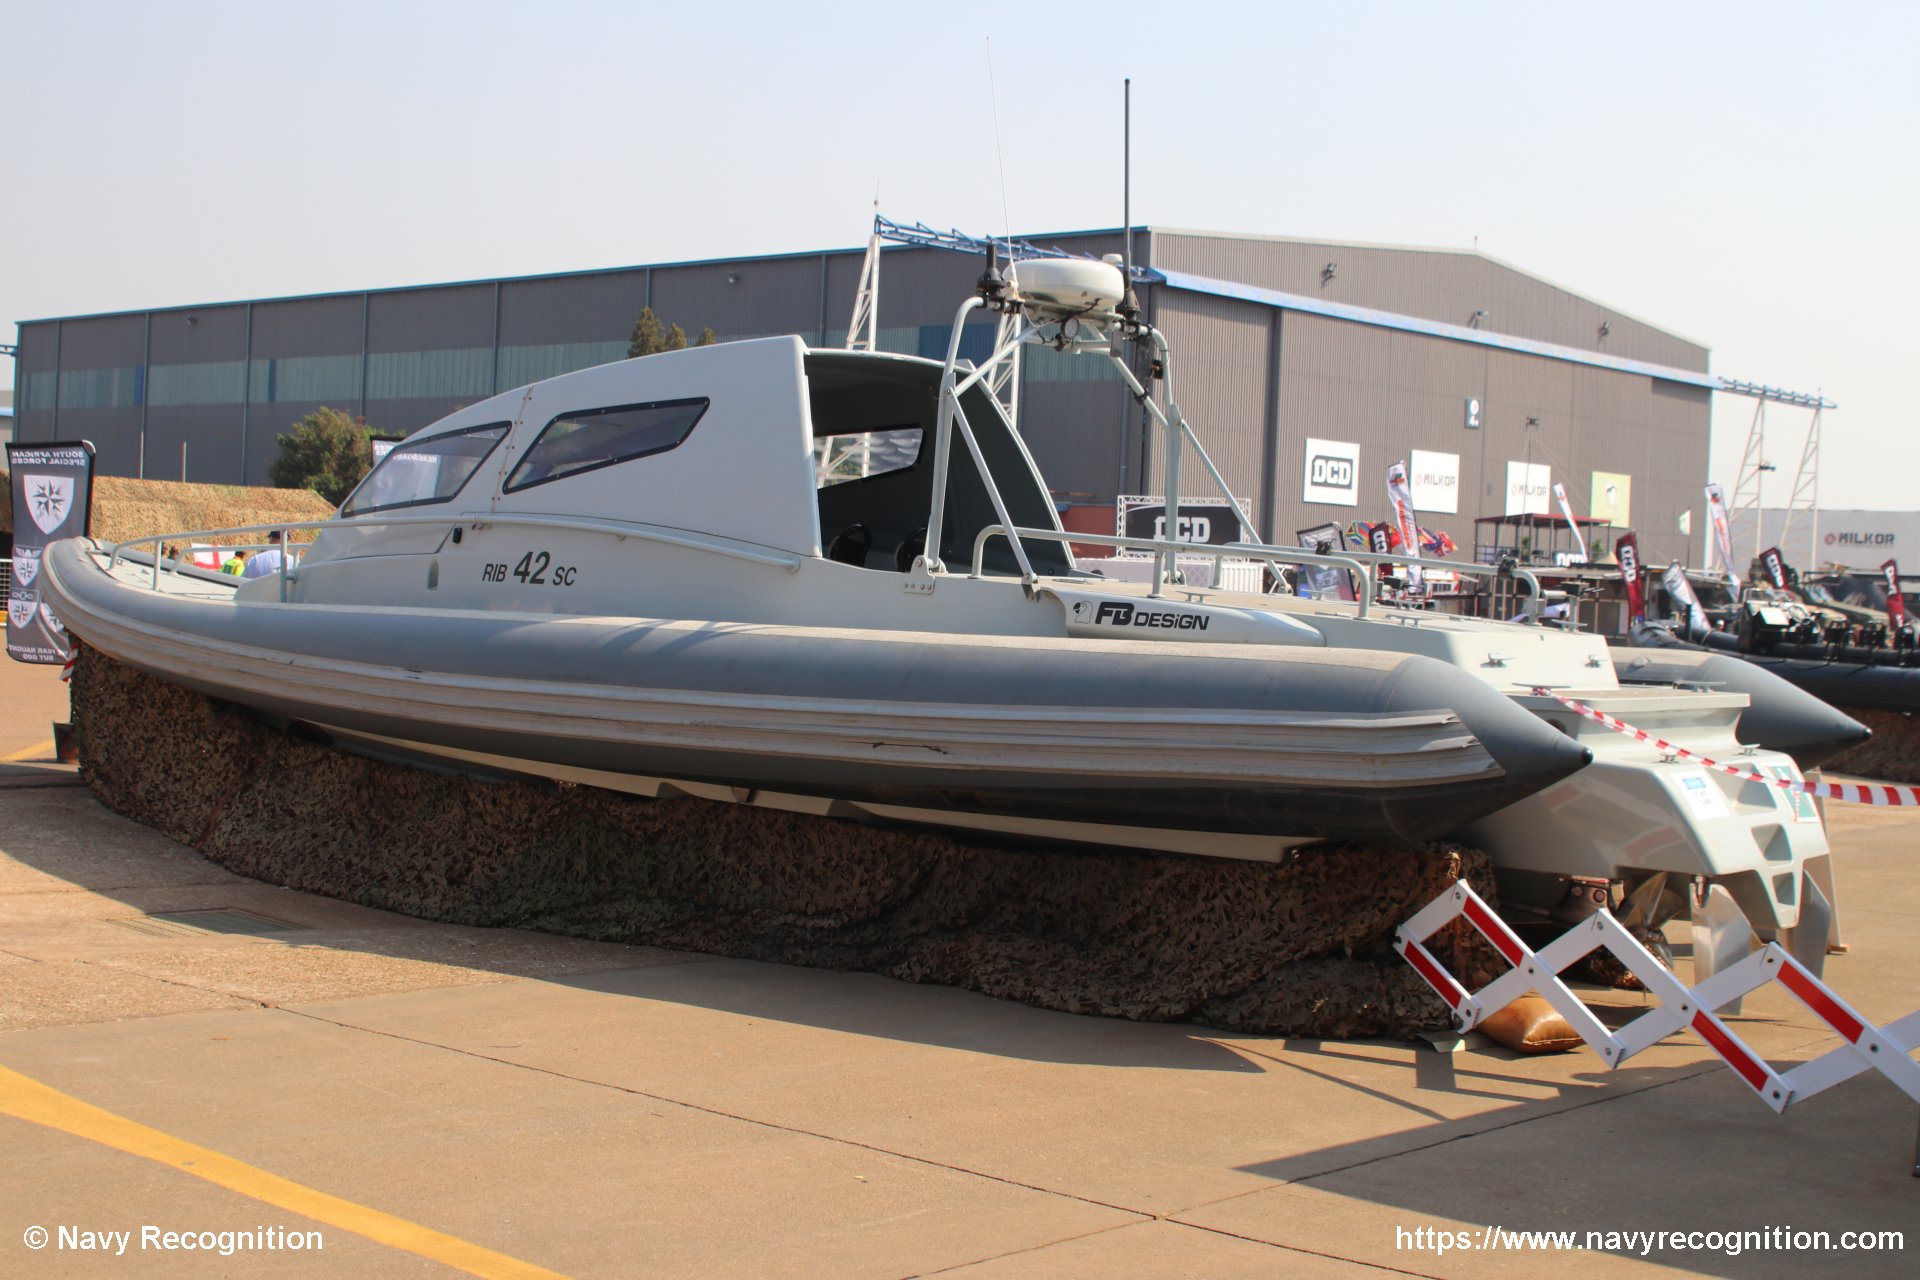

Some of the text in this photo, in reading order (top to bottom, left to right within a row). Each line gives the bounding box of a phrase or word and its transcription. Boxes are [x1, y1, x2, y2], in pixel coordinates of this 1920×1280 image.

[1312, 458, 1352, 486] DCD
[1423, 474, 1456, 487] MILKOR
[1838, 532, 1895, 545] MILKOR
[482, 551, 577, 586] RIB 42 SC
